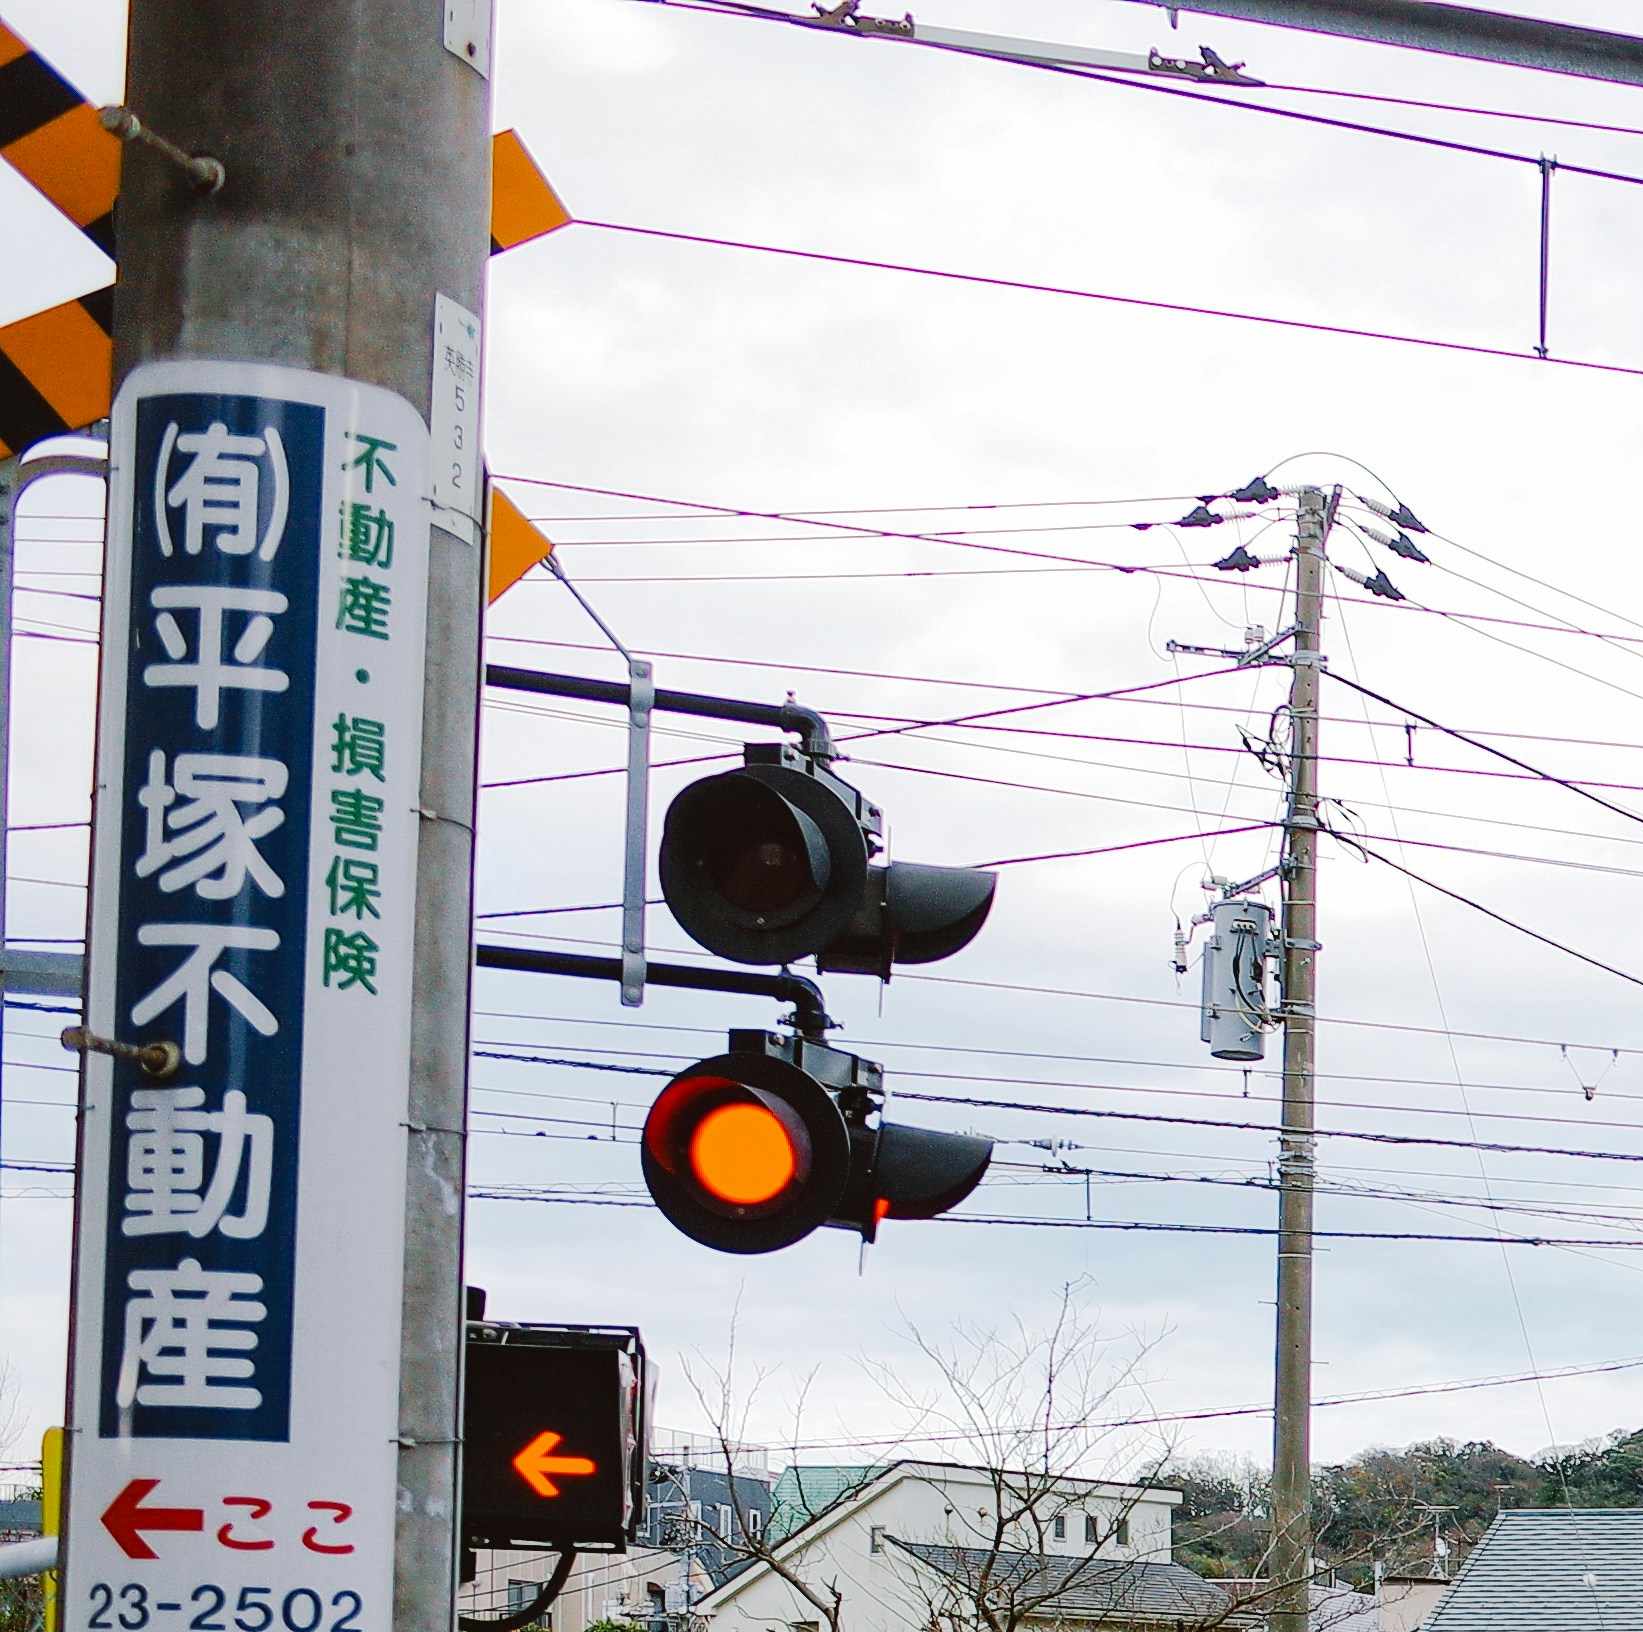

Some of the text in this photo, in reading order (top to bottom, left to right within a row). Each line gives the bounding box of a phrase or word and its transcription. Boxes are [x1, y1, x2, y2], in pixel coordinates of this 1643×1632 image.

[322, 430, 398, 997] 不動産・損害保険
[216, 1496, 355, 1555] ここ
